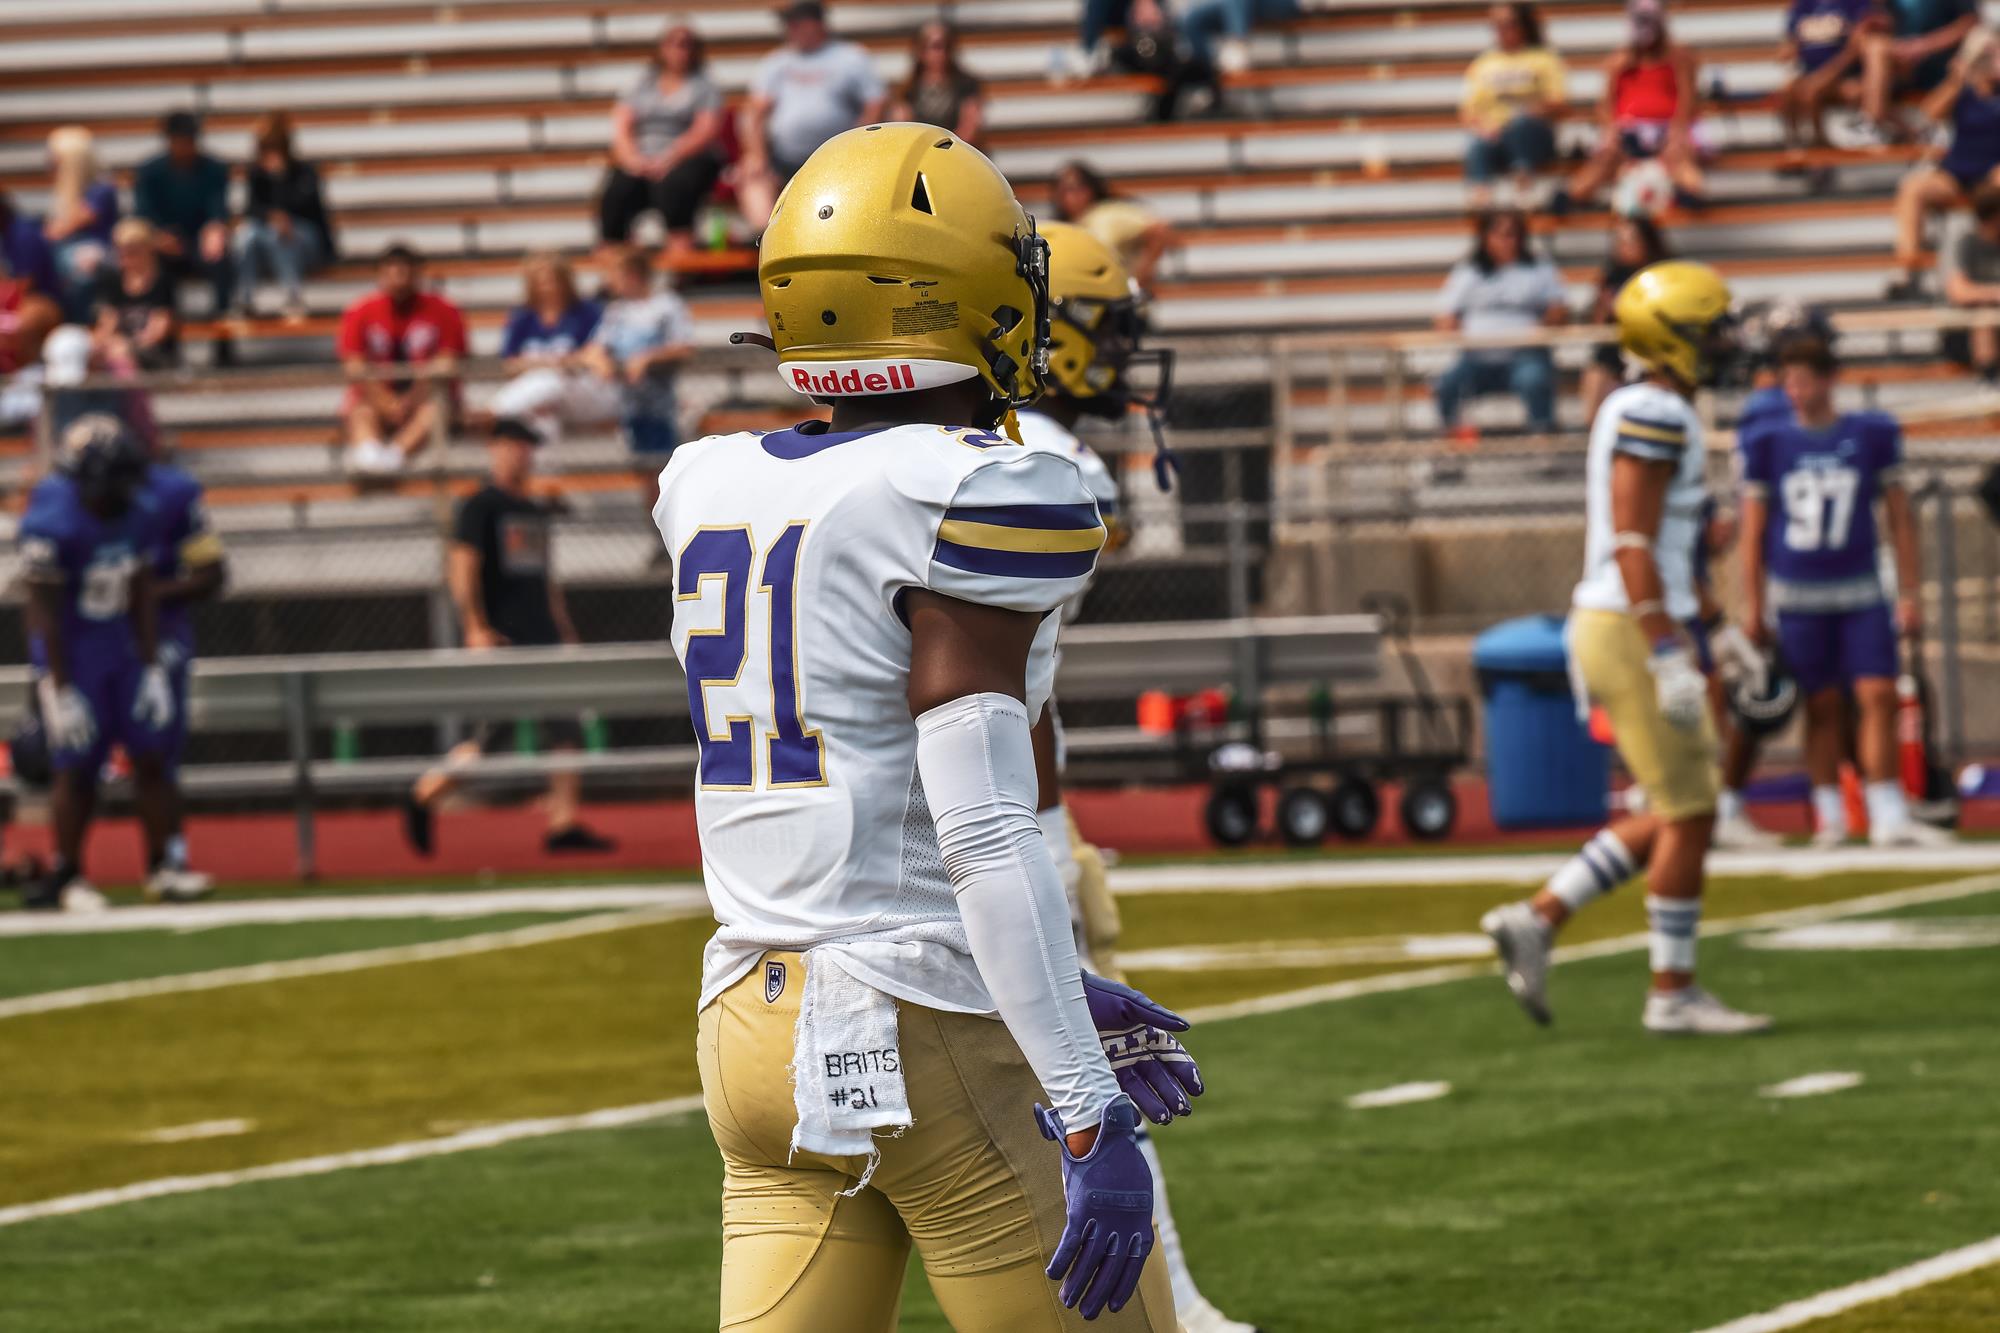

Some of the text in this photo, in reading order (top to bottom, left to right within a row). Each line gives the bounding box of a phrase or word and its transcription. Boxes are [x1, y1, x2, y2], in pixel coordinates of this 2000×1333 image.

[791, 364, 915, 394] Riddell
[1782, 468, 1859, 550] 97
[676, 518, 830, 792] 21
[828, 1085, 878, 1110] #21
